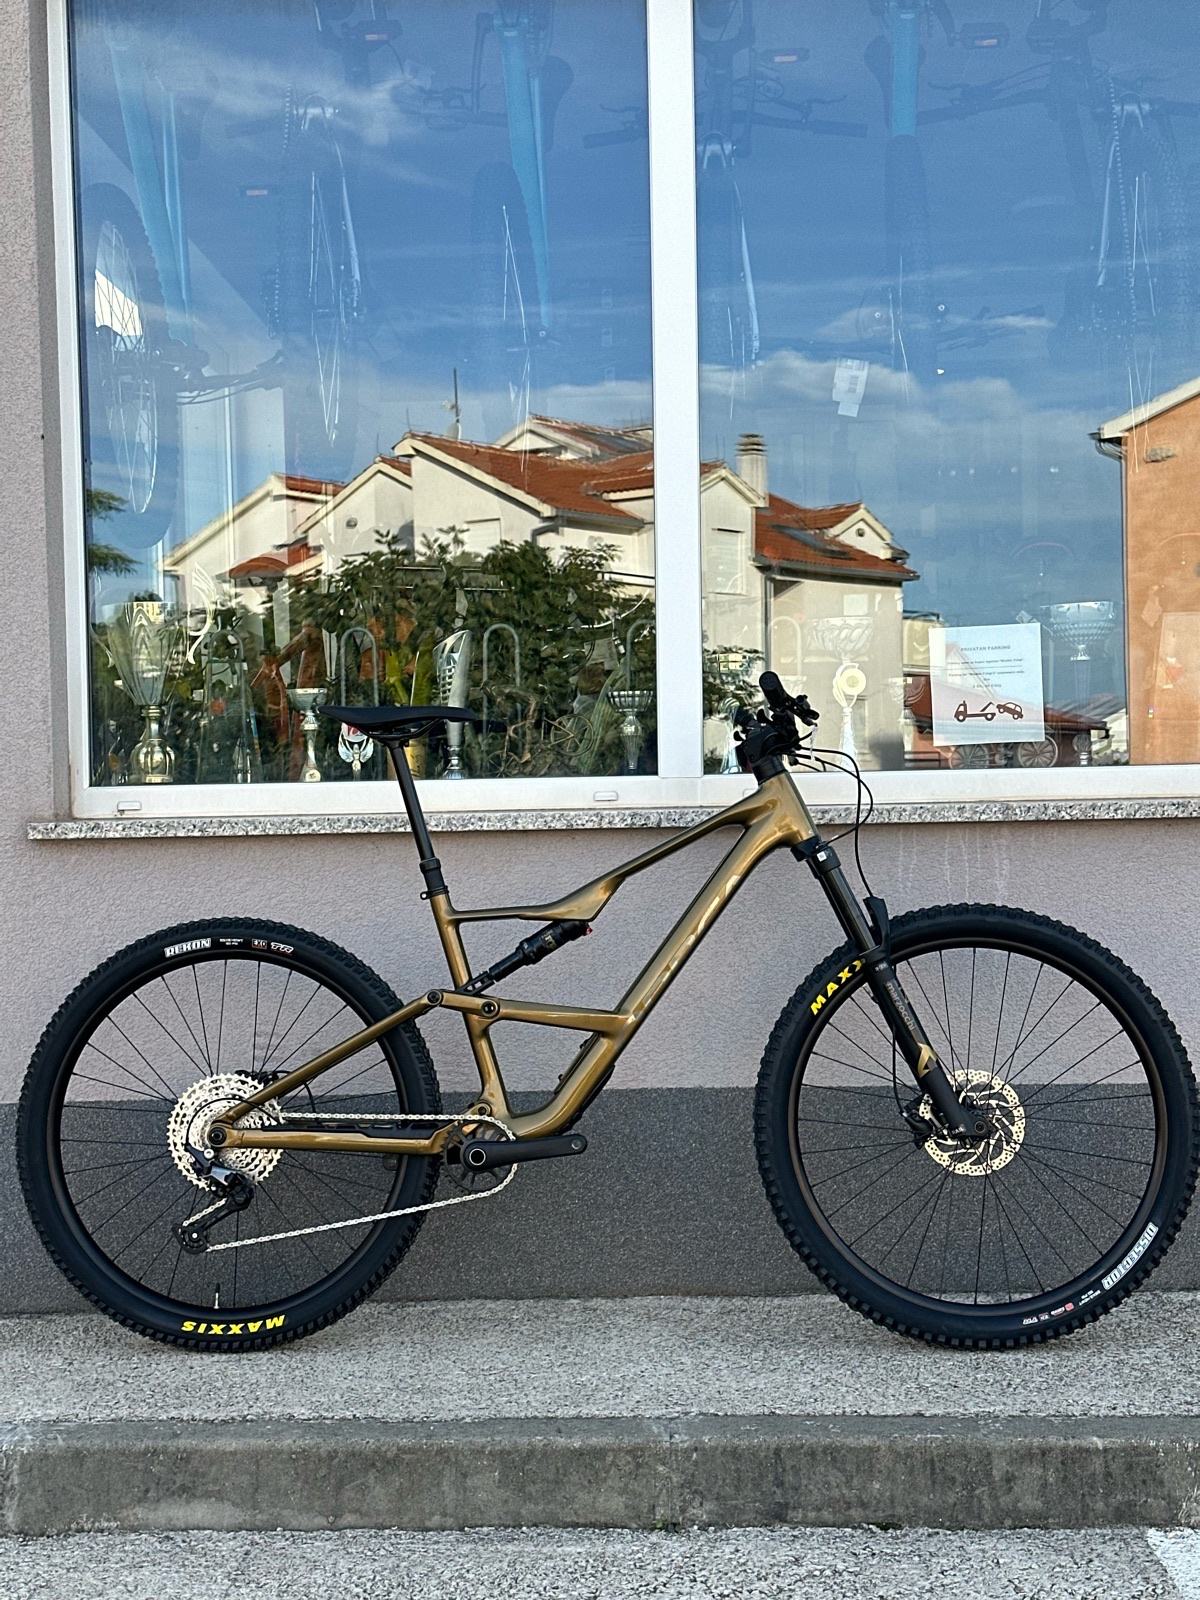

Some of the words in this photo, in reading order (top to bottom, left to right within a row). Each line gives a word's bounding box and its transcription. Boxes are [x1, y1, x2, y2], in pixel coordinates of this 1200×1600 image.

[164, 937, 212, 957] REKON
[252, 938, 268, 949] EXO
[886, 982, 917, 1031] marzocchi
[1101, 1221, 1159, 1290] DISSECTOR
[181, 1315, 285, 1335] MAXXIS
